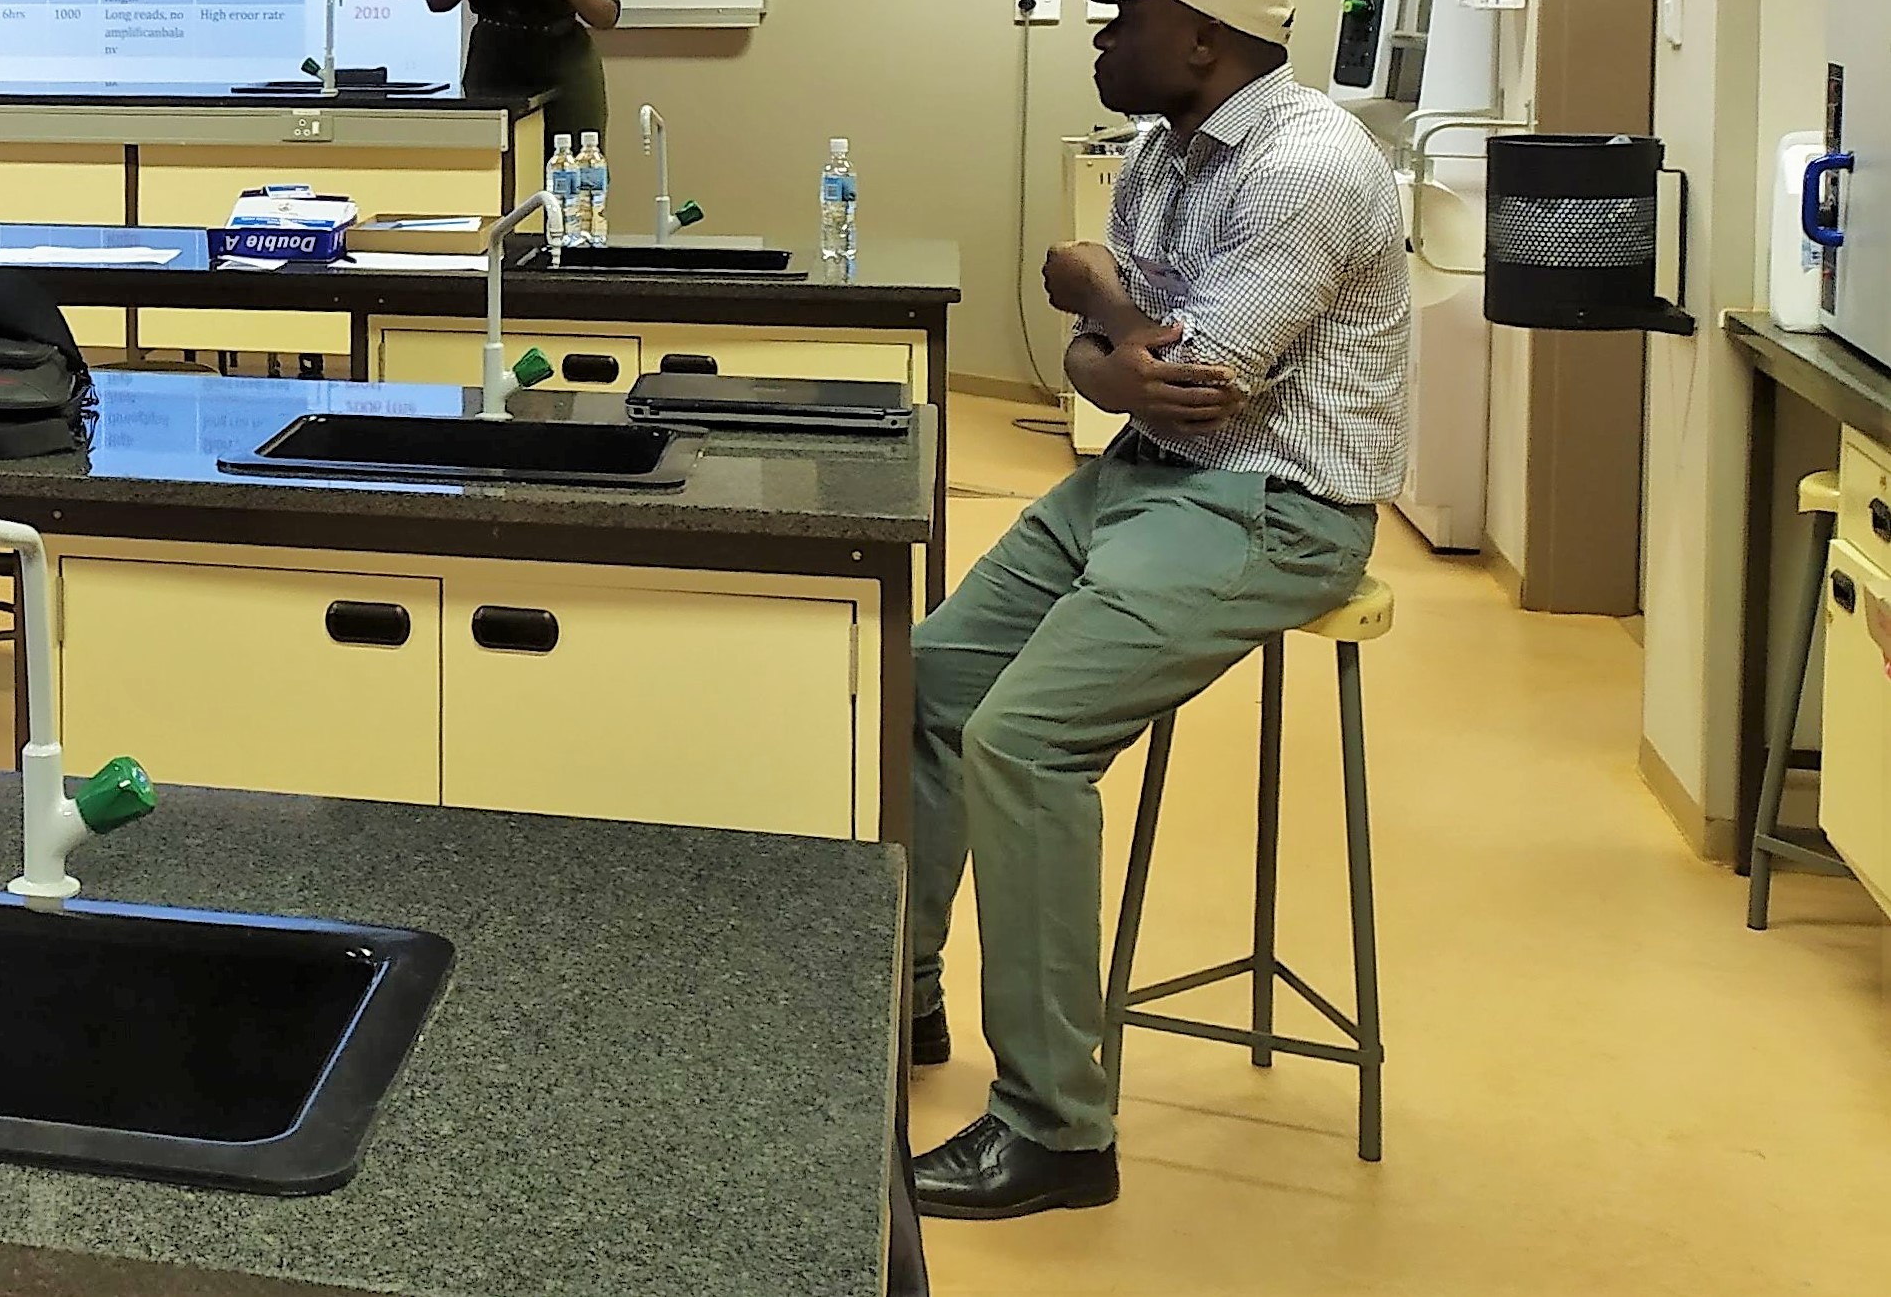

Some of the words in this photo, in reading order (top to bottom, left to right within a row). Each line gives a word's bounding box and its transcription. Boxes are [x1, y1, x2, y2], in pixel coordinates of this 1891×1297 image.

[2, 8, 26, 19] 6hrs
[54, 9, 81, 20] 1000
[105, 10, 132, 23] Long
[133, 10, 168, 22] reads,
[170, 11, 184, 21] no
[200, 10, 227, 23] High
[262, 9, 286, 20] rate
[354, 6, 391, 20] 2010
[224, 235, 240, 251] A
[246, 234, 317, 253] Double
